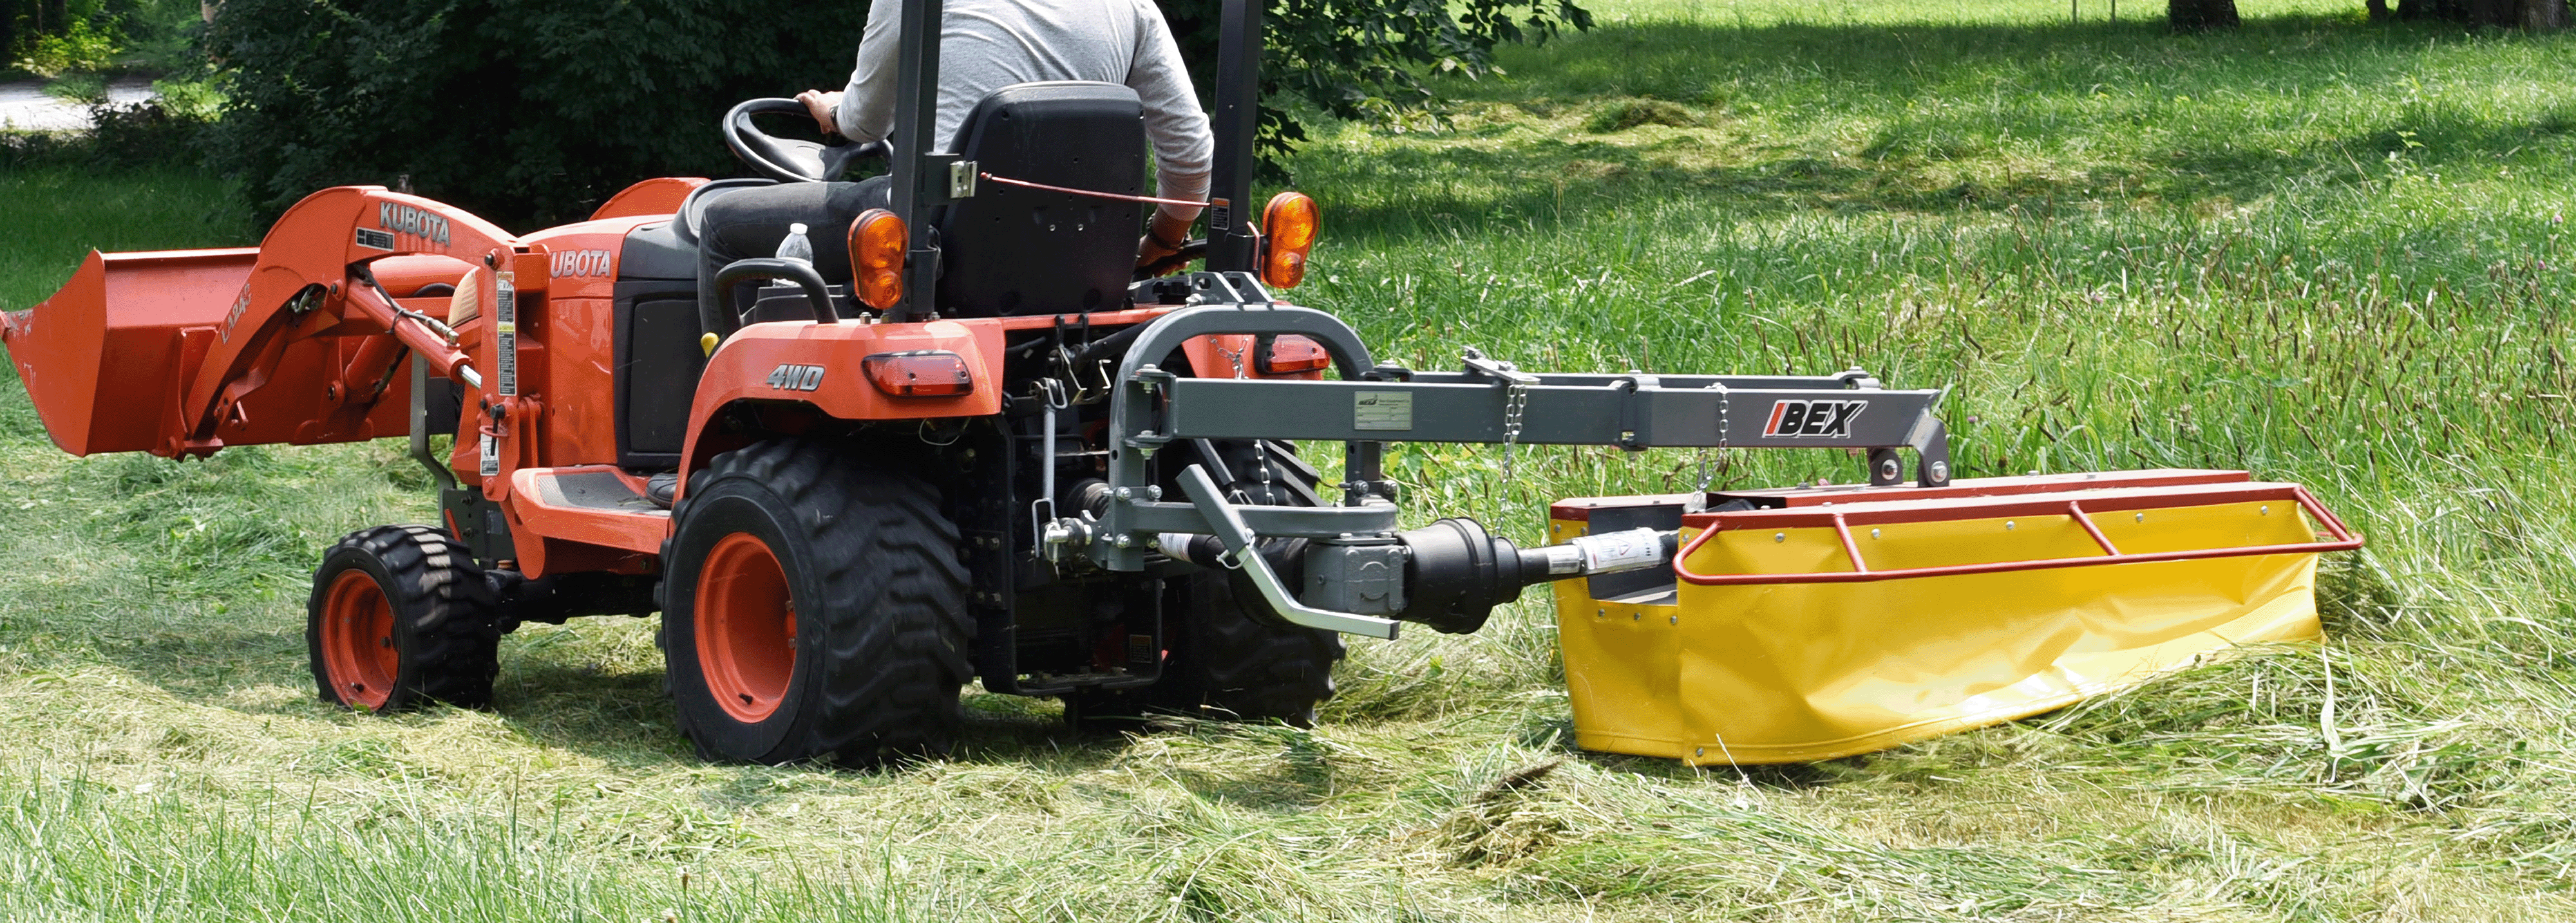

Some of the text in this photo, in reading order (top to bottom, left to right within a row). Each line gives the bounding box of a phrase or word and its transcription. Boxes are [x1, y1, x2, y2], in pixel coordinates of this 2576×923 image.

[379, 200, 450, 247] KUBOTA
[551, 249, 611, 278] UBOTA
[766, 364, 825, 390] 4WD
[1762, 399, 1869, 438] IBEX
